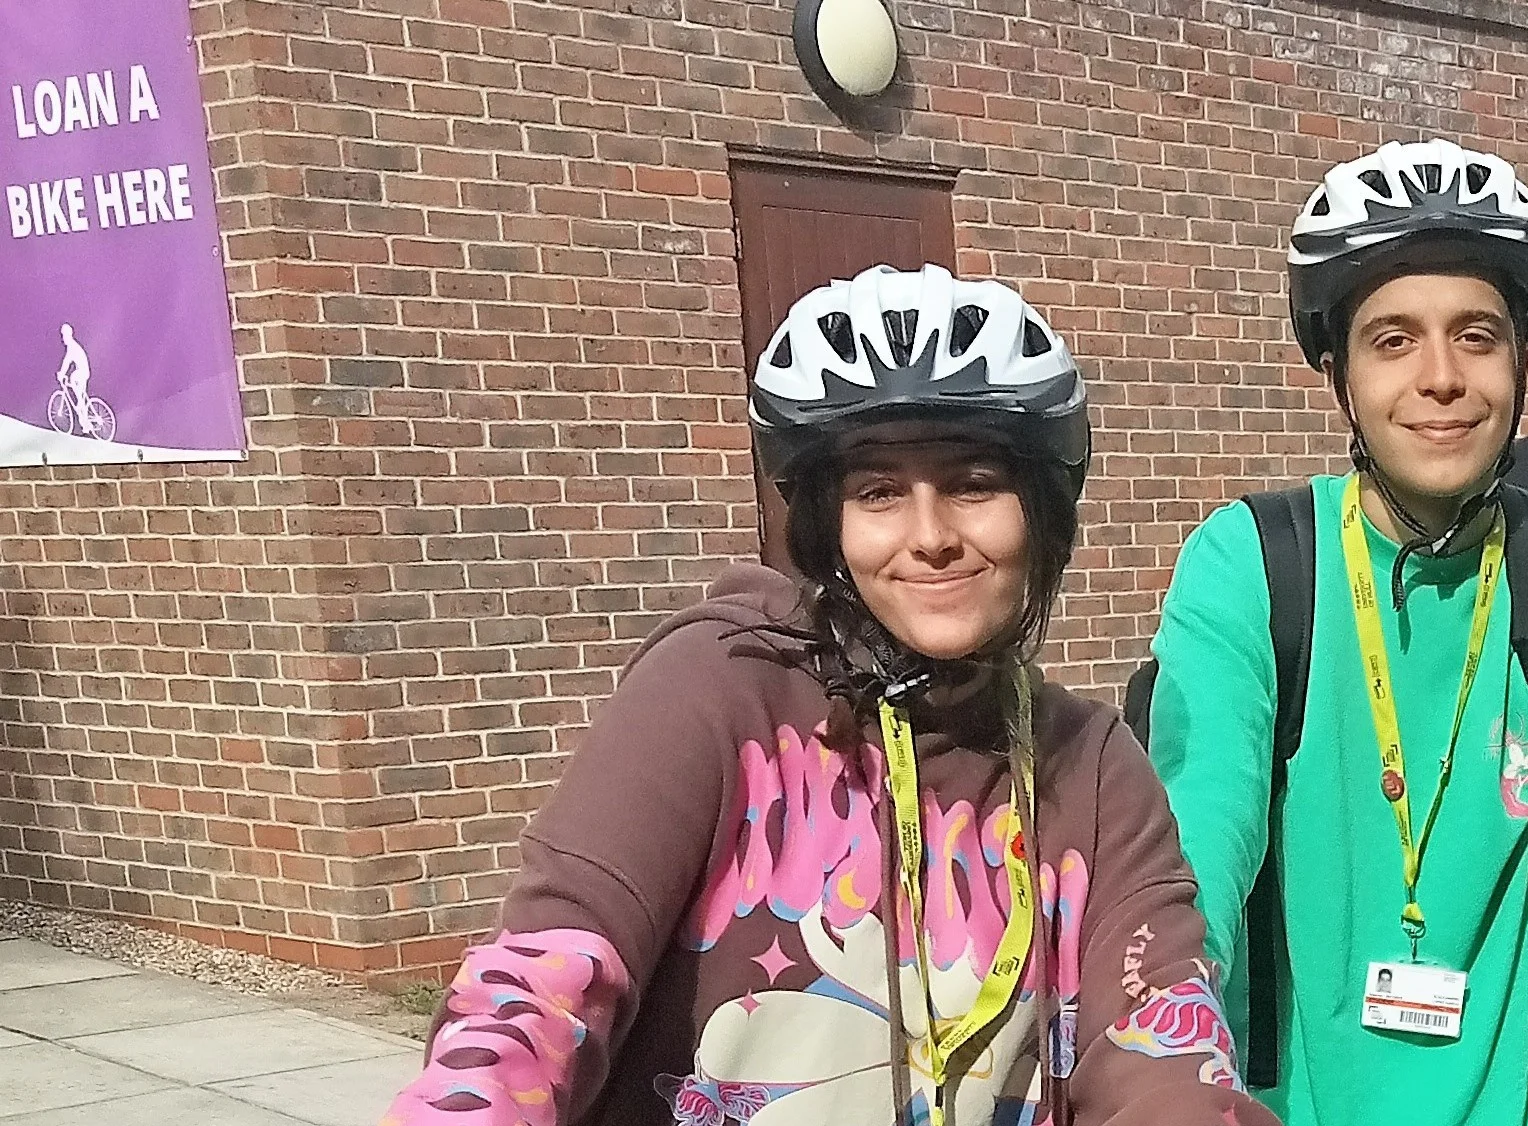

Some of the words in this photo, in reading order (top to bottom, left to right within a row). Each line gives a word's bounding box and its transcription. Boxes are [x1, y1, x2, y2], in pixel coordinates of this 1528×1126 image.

[12, 69, 119, 139] LOAN
[129, 64, 160, 123] A
[6, 177, 89, 239] BIKE
[94, 164, 194, 229] HERE
